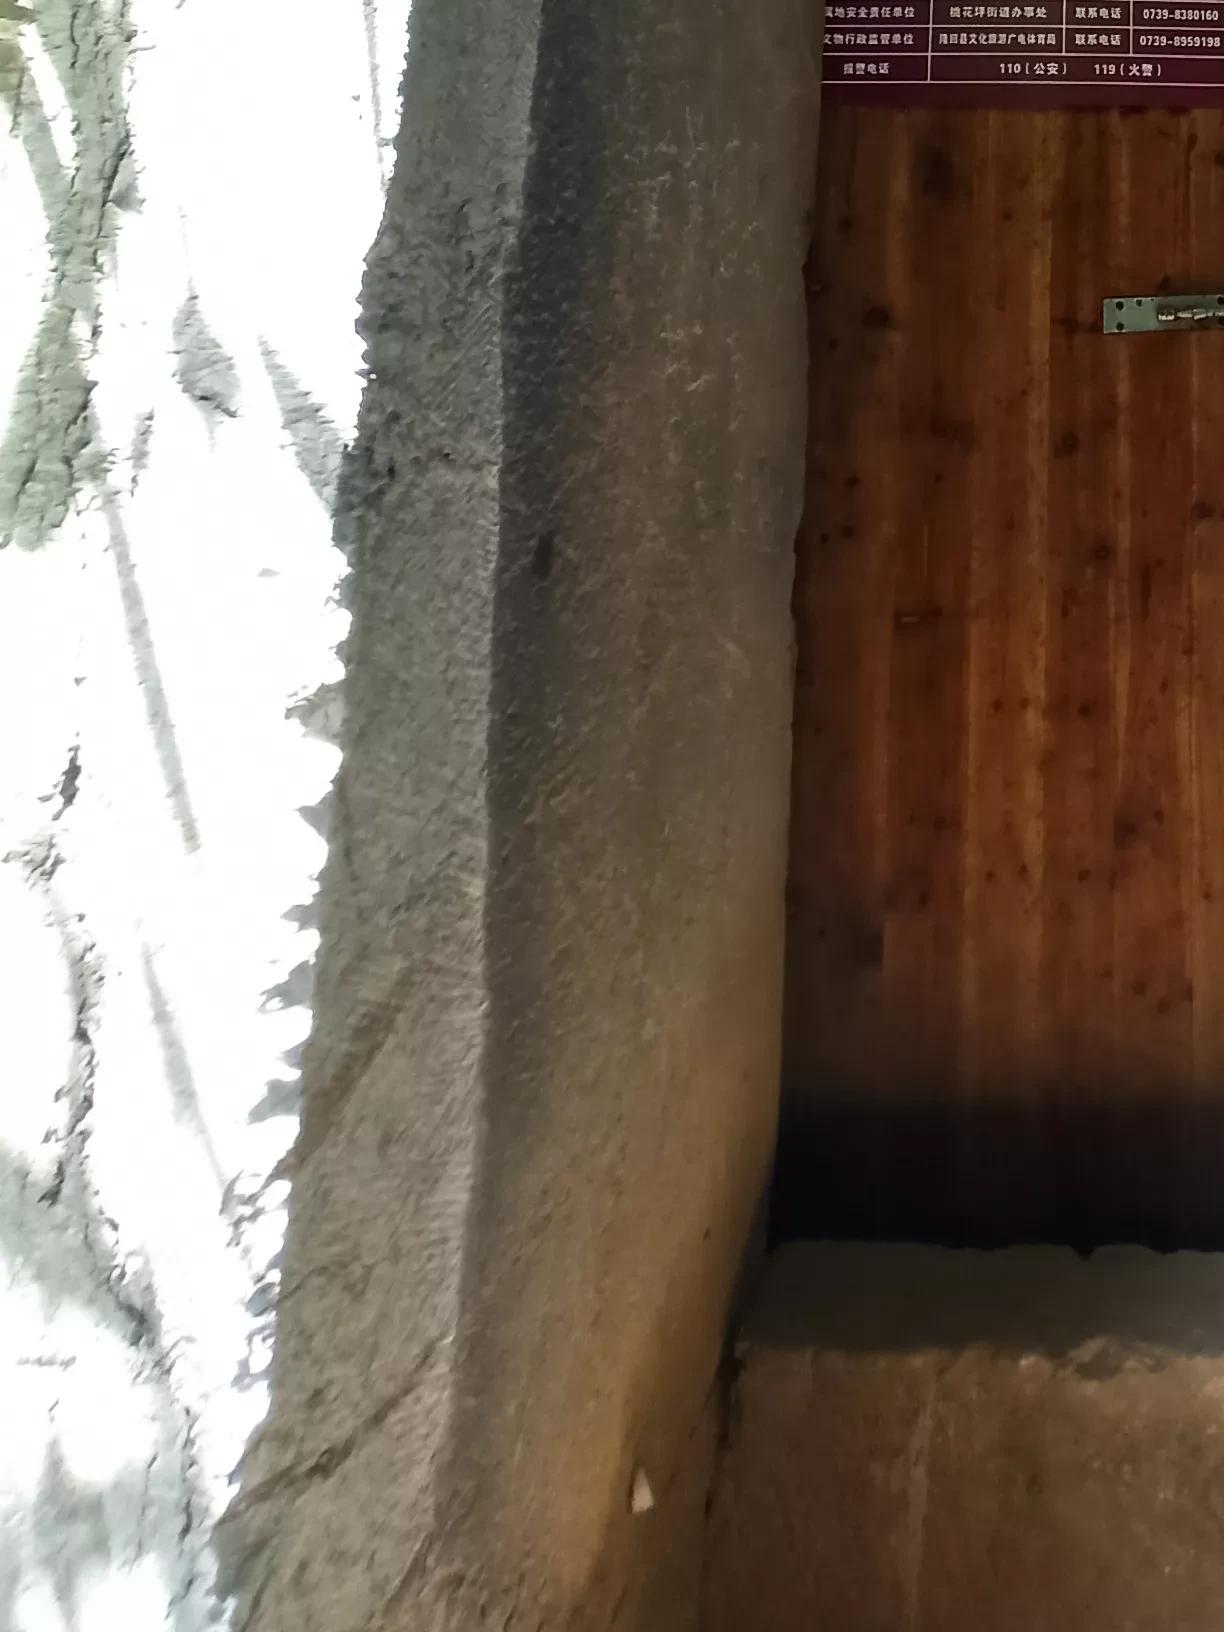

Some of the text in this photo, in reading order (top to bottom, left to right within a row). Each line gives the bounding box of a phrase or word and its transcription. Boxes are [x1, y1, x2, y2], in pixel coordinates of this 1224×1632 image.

[1075, 7, 1122, 19] 联系电话
[1143, 8, 1219, 21] 0739-8380160
[1074, 33, 1121, 46] 联系电话
[1139, 35, 1221, 48] 0739-8959198
[843, 62, 889, 75] 报警电话
